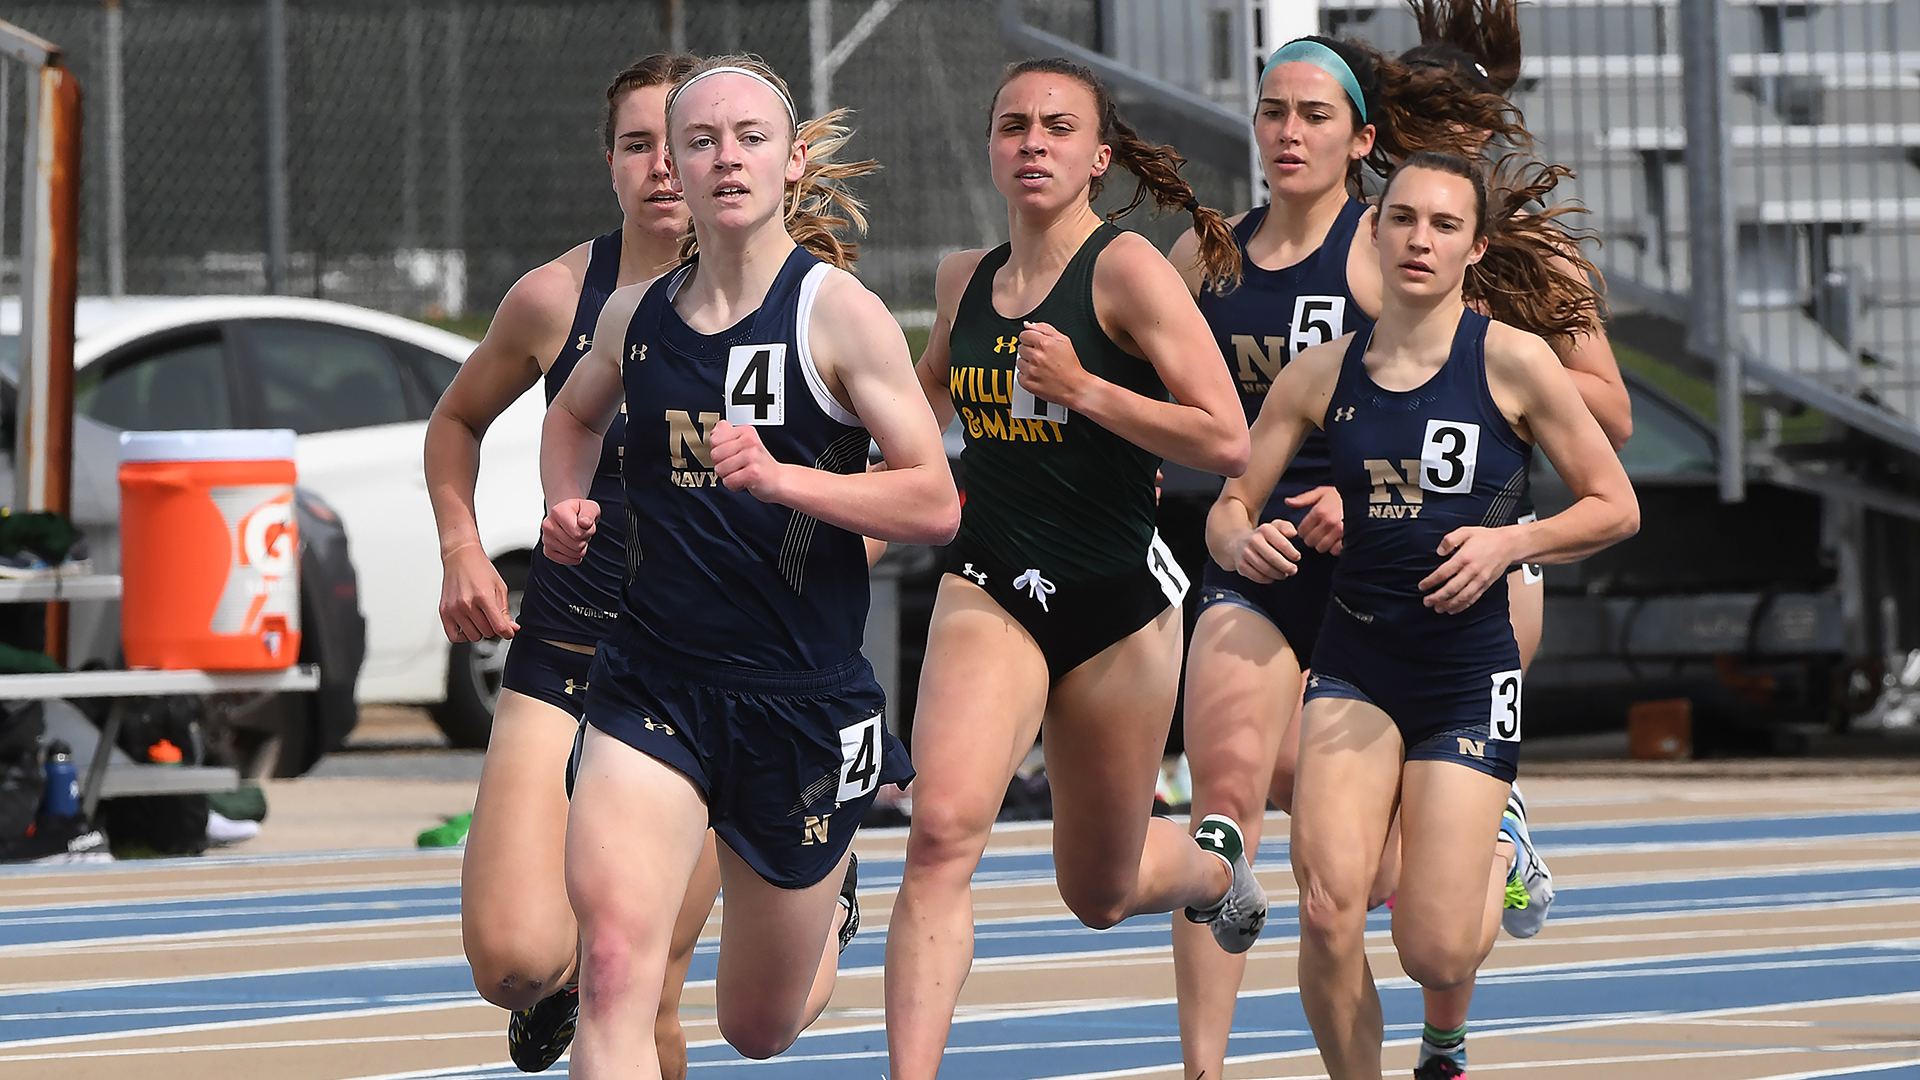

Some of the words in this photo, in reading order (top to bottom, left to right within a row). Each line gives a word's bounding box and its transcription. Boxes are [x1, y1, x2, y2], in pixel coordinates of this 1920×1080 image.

[1297, 301, 1333, 353] 5
[1231, 334, 1285, 381] N
[732, 350, 775, 420] 4
[950, 366, 1014, 404] WILLI
[665, 409, 720, 469] N
[1426, 426, 1467, 489] 3
[671, 470, 719, 488] NAVY
[1363, 459, 1424, 504] N
[1368, 504, 1423, 519] NAVY
[1496, 677, 1518, 739] 3
[845, 723, 877, 792] 4
[1456, 736, 1486, 760] N
[801, 813, 833, 845] N
